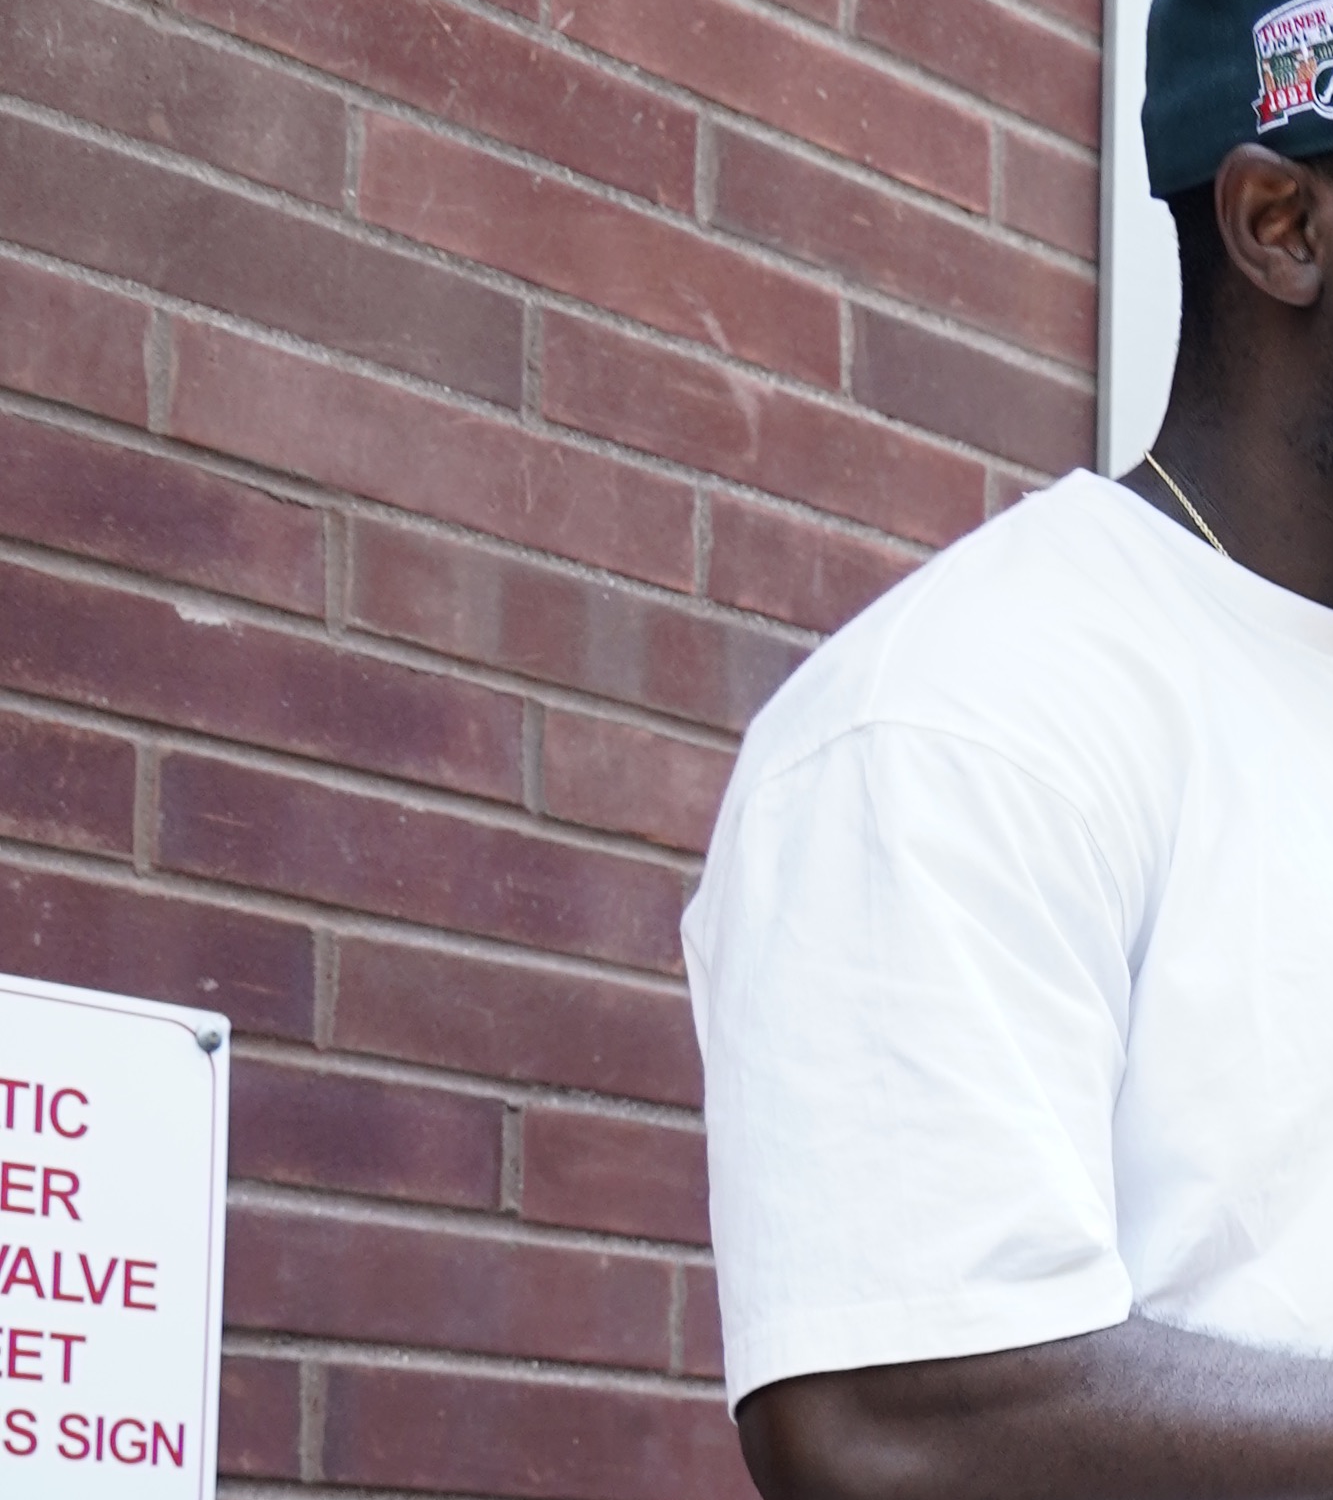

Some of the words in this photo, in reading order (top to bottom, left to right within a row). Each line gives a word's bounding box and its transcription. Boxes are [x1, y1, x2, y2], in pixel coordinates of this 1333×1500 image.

[1258, 9, 1326, 43] TURNER
[0, 1330, 87, 1383] ET
[57, 1414, 186, 1468] SIGN
